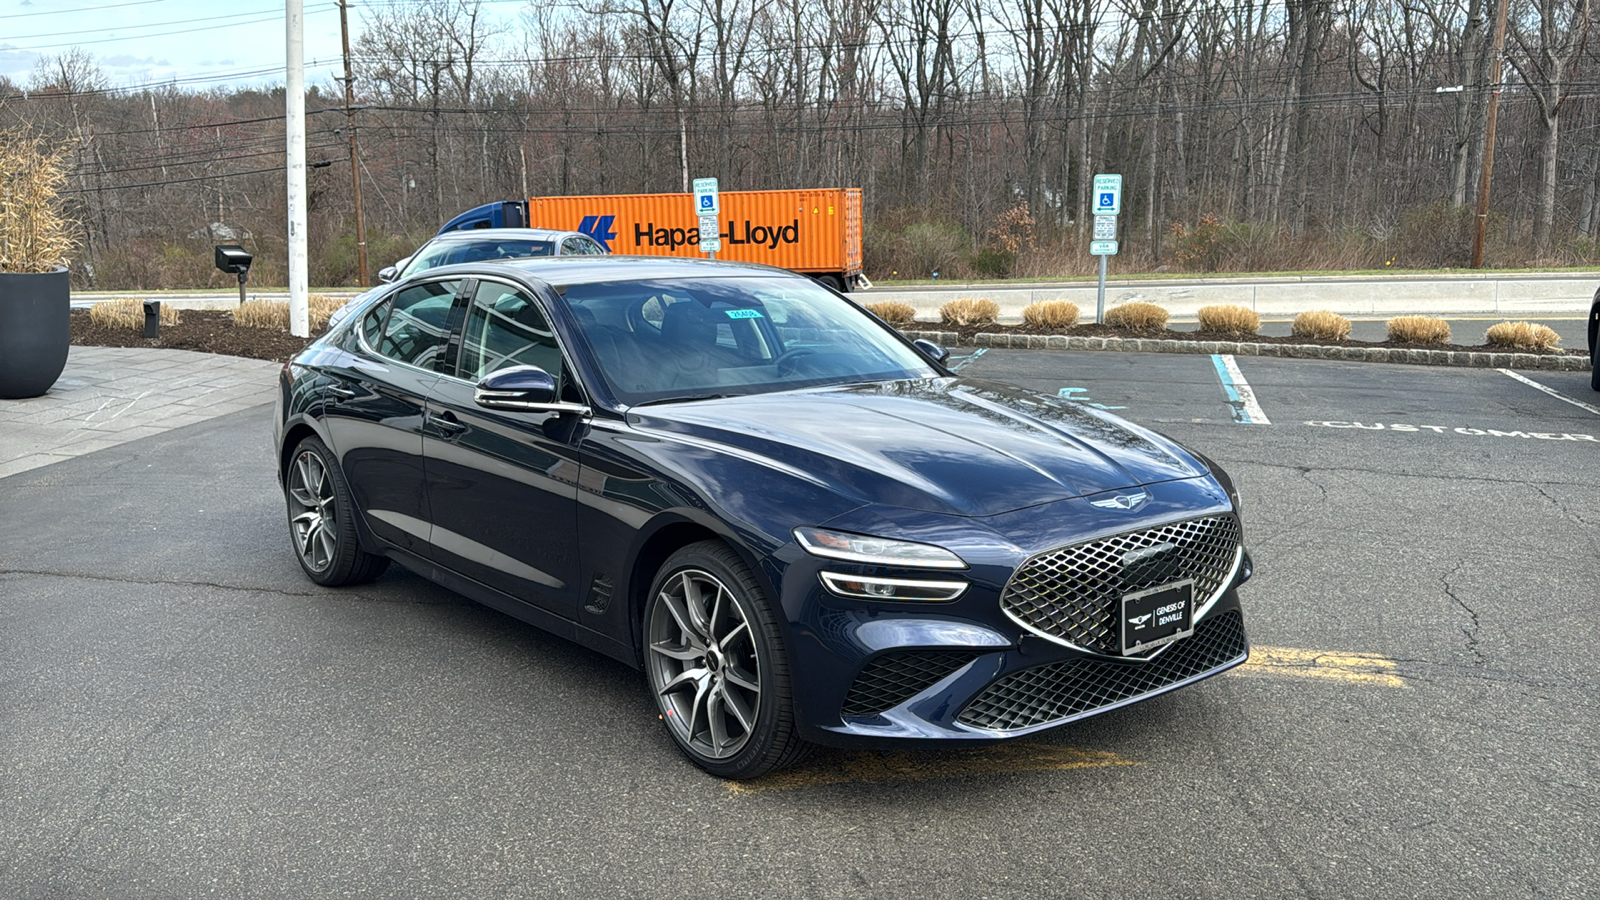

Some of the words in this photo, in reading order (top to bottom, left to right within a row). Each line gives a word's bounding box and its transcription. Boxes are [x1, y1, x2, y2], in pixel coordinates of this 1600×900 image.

[634, 219, 799, 251] Hapa-Lloyd
[1320, 420, 1600, 443] CUSTOMER
[1156, 602, 1177, 616] GENESIS
[1177, 600, 1186, 610] OF
[1159, 611, 1183, 626] DENVILLE
